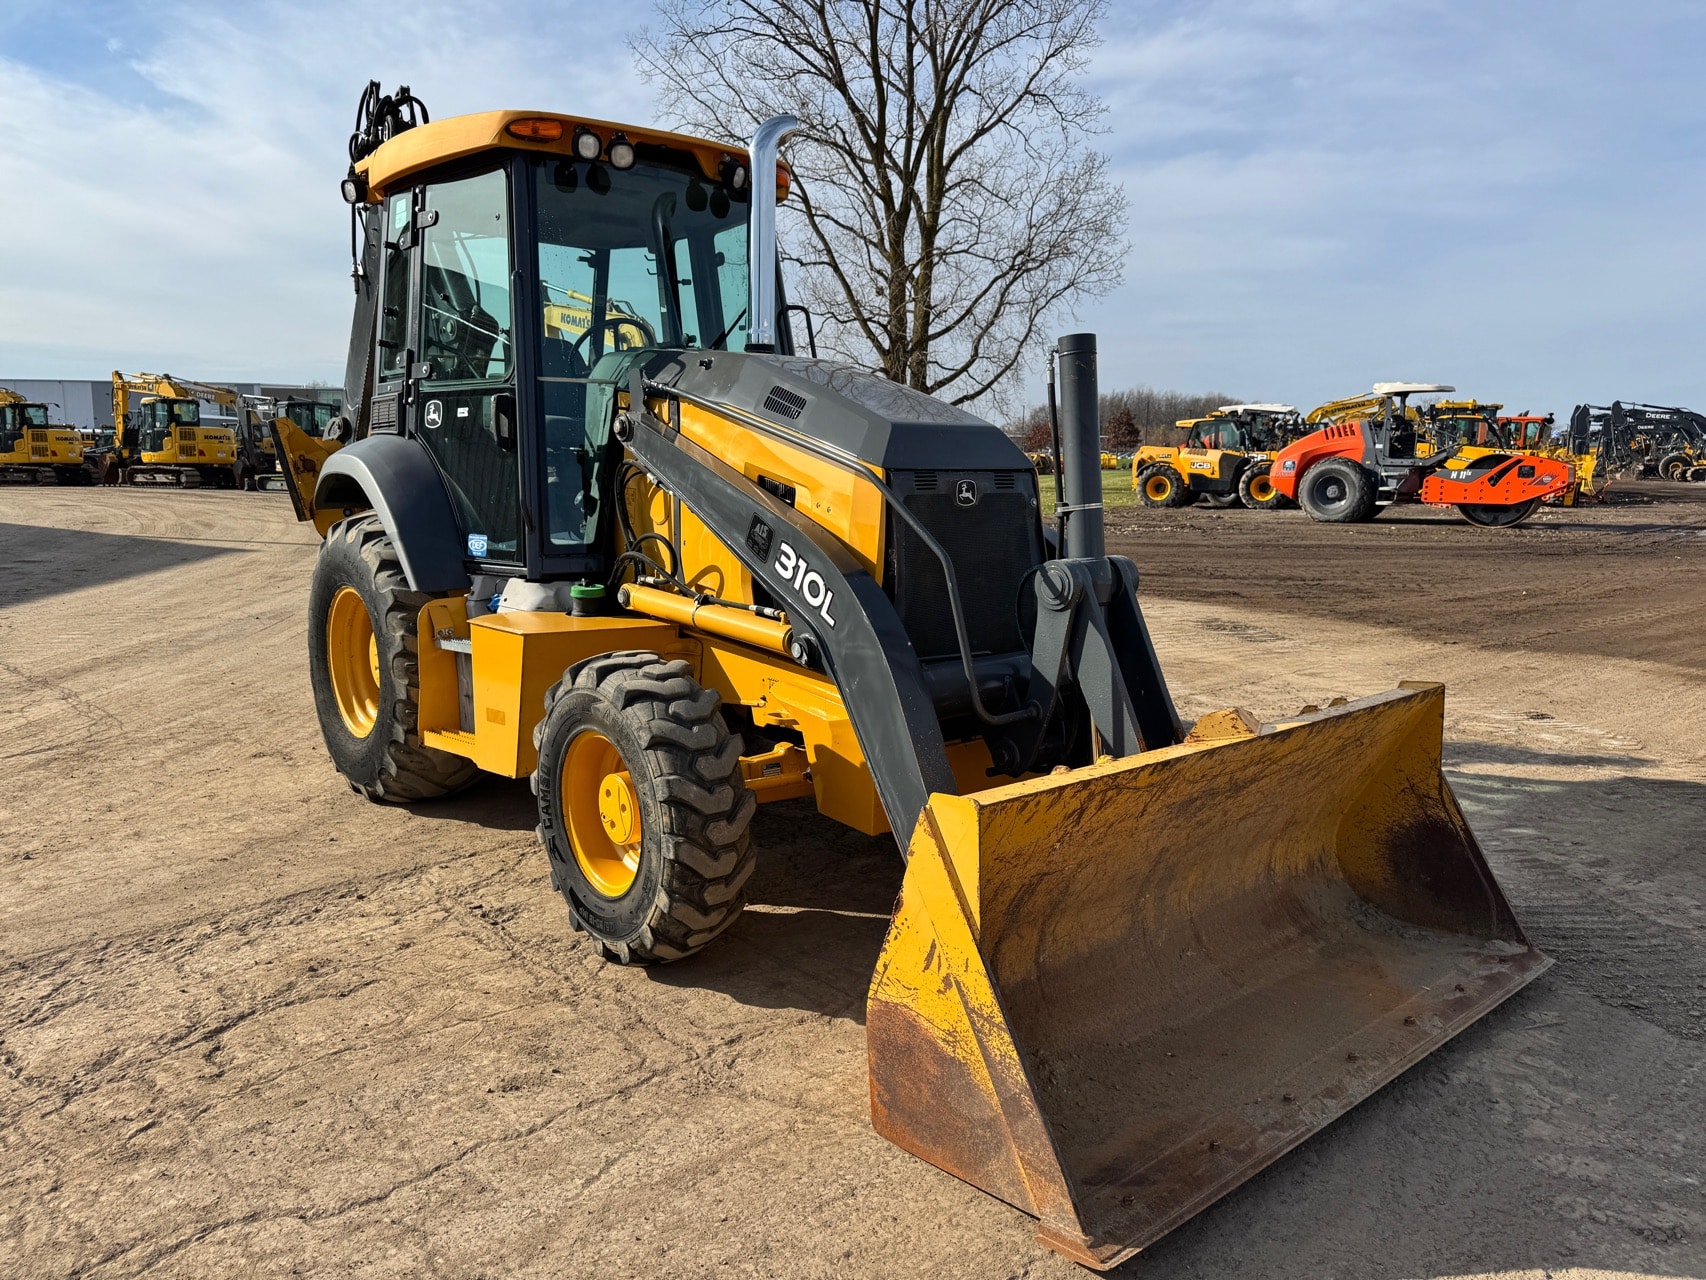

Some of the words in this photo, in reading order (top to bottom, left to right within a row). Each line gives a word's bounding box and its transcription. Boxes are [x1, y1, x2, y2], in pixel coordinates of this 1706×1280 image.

[560, 312, 591, 329] KOMATS
[1645, 412, 1672, 420] DEERE
[1190, 461, 1211, 469] JCB
[774, 541, 836, 628] 310L
